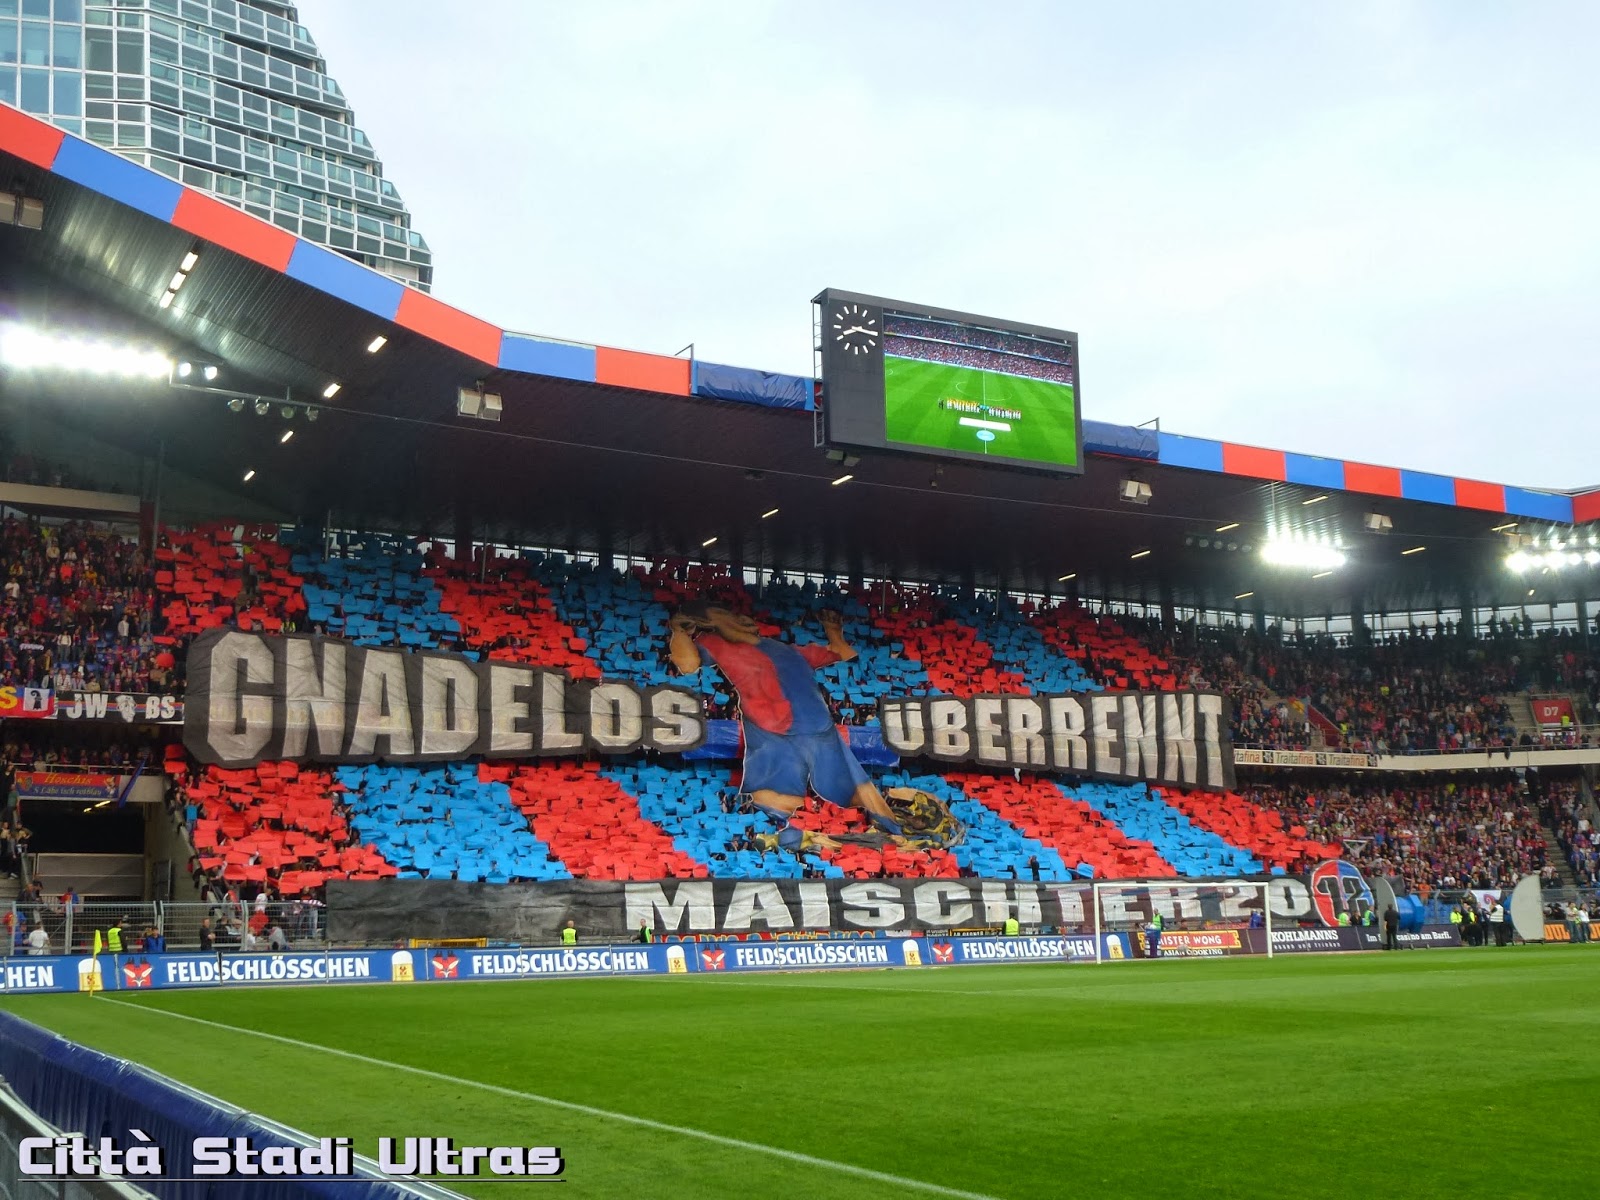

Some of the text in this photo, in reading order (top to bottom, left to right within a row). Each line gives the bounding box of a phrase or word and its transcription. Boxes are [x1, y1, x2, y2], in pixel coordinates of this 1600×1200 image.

[66, 693, 176, 719] JW BS
[207, 631, 1223, 787] GNADELOS ÜBERRENNT
[1543, 706, 1559, 716] D7
[1235, 750, 1260, 763] tafina
[1276, 752, 1314, 765] Traitafina
[1329, 754, 1365, 766] Traitafina
[624, 881, 1203, 930] MAISCHTER
[1193, 934, 1222, 945] WONG
[1270, 930, 1339, 942] KOHLMANNS
[736, 943, 888, 966] FELDSCHLÖSSCHEN
[962, 937, 1095, 959] FELDSCHLÖSSCHEN
[167, 955, 370, 983] FELDSCHLÖSSCHEN
[472, 951, 649, 975] FELDSCHLÖSSCHEN
